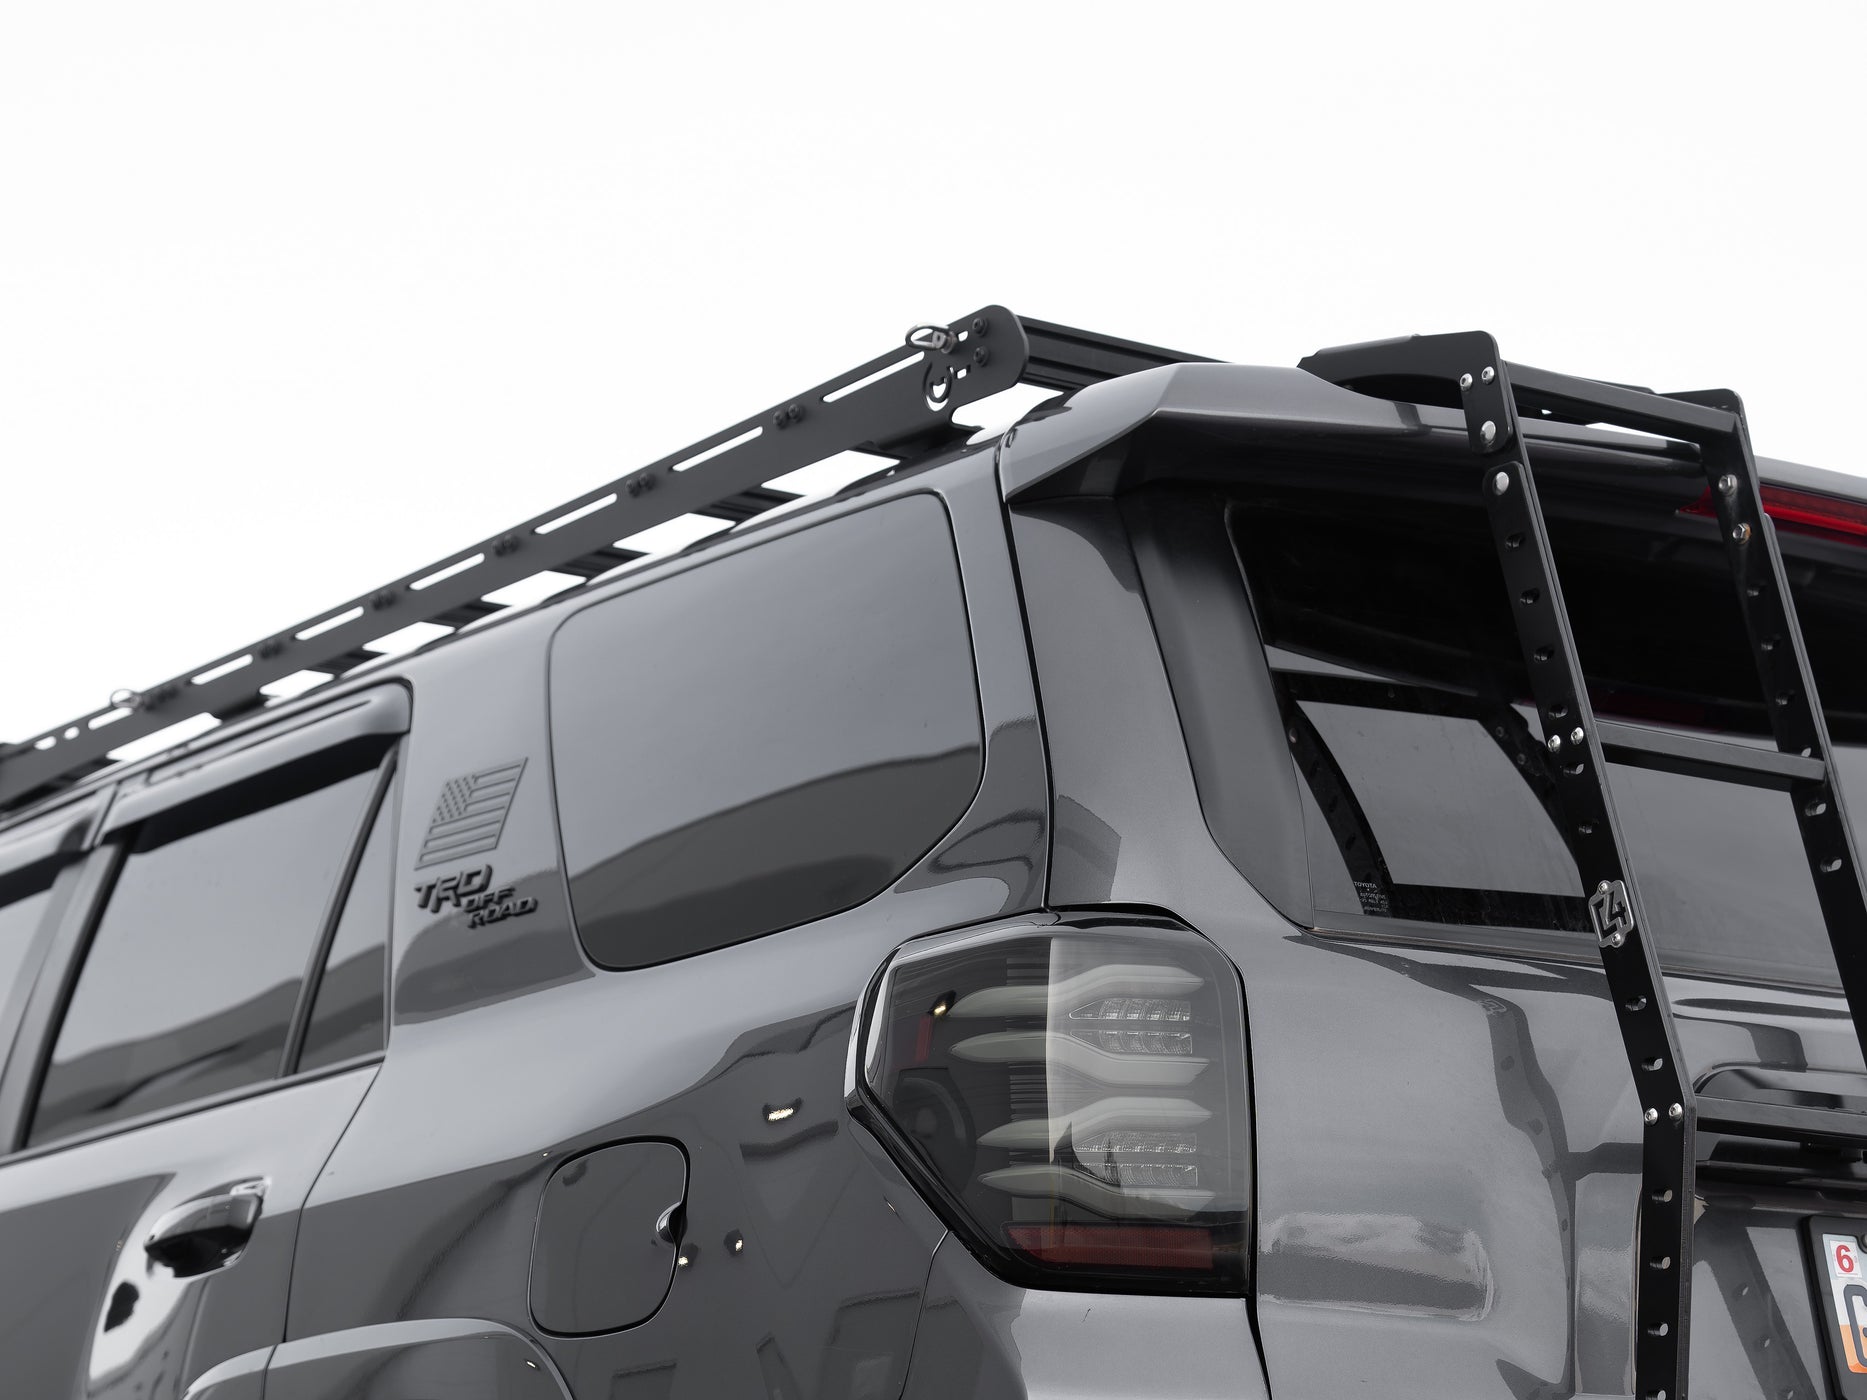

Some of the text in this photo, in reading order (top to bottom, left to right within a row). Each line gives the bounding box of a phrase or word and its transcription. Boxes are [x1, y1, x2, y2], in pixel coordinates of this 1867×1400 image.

[414, 864, 493, 914] TRD
[461, 886, 516, 914] OFF
[1353, 881, 1378, 889] TOYOTA
[468, 897, 539, 929] ROAD
[1835, 1244, 1855, 1274] 6
